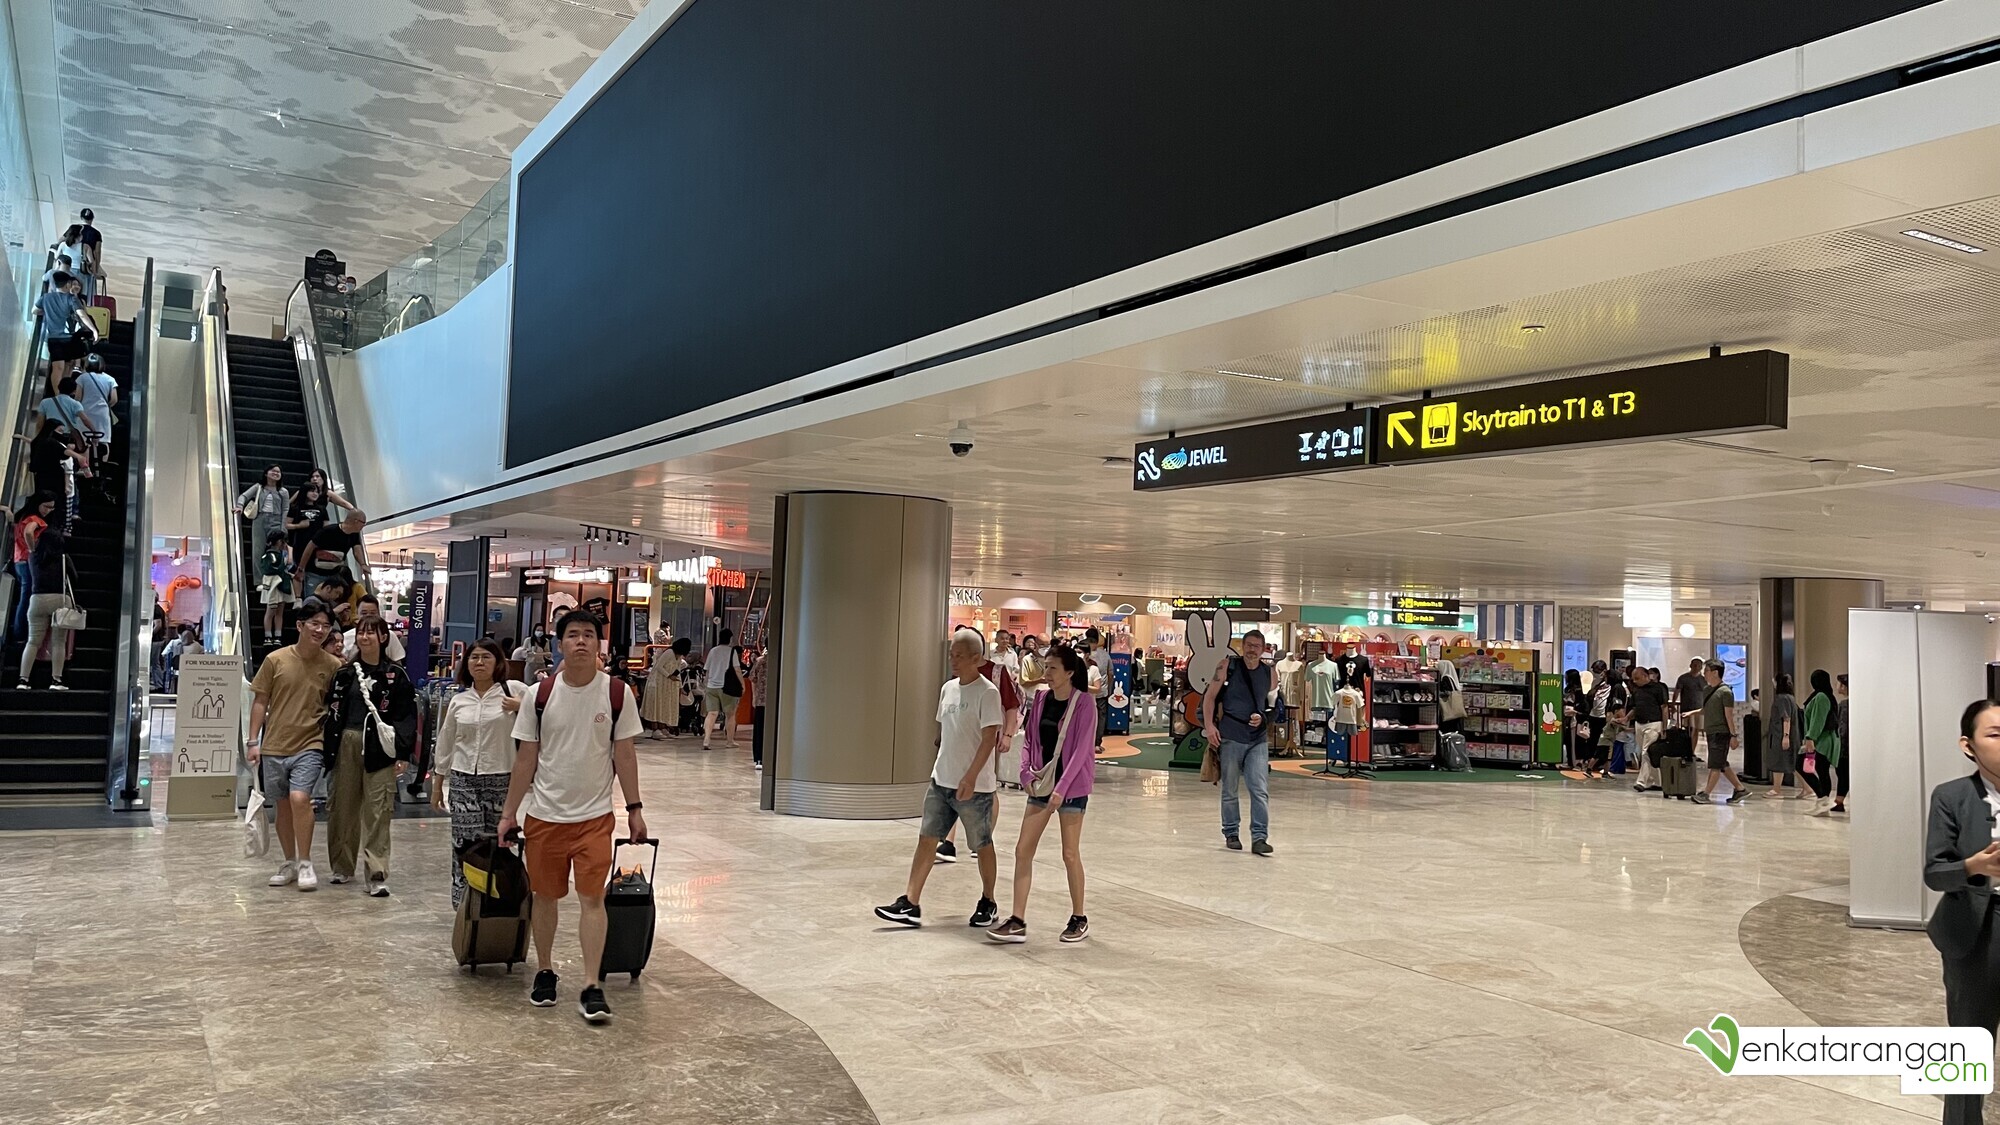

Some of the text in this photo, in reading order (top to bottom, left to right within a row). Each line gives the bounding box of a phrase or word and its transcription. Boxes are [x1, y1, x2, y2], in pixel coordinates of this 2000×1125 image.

[1462, 391, 1636, 435] Skytrain to T1 & T3
[1188, 446, 1227, 467] JEWEL
[706, 567, 745, 589] KITCHEN
[950, 588, 983, 601] YNK
[412, 585, 428, 629] Trolleys
[1540, 679, 1561, 688] miffy
